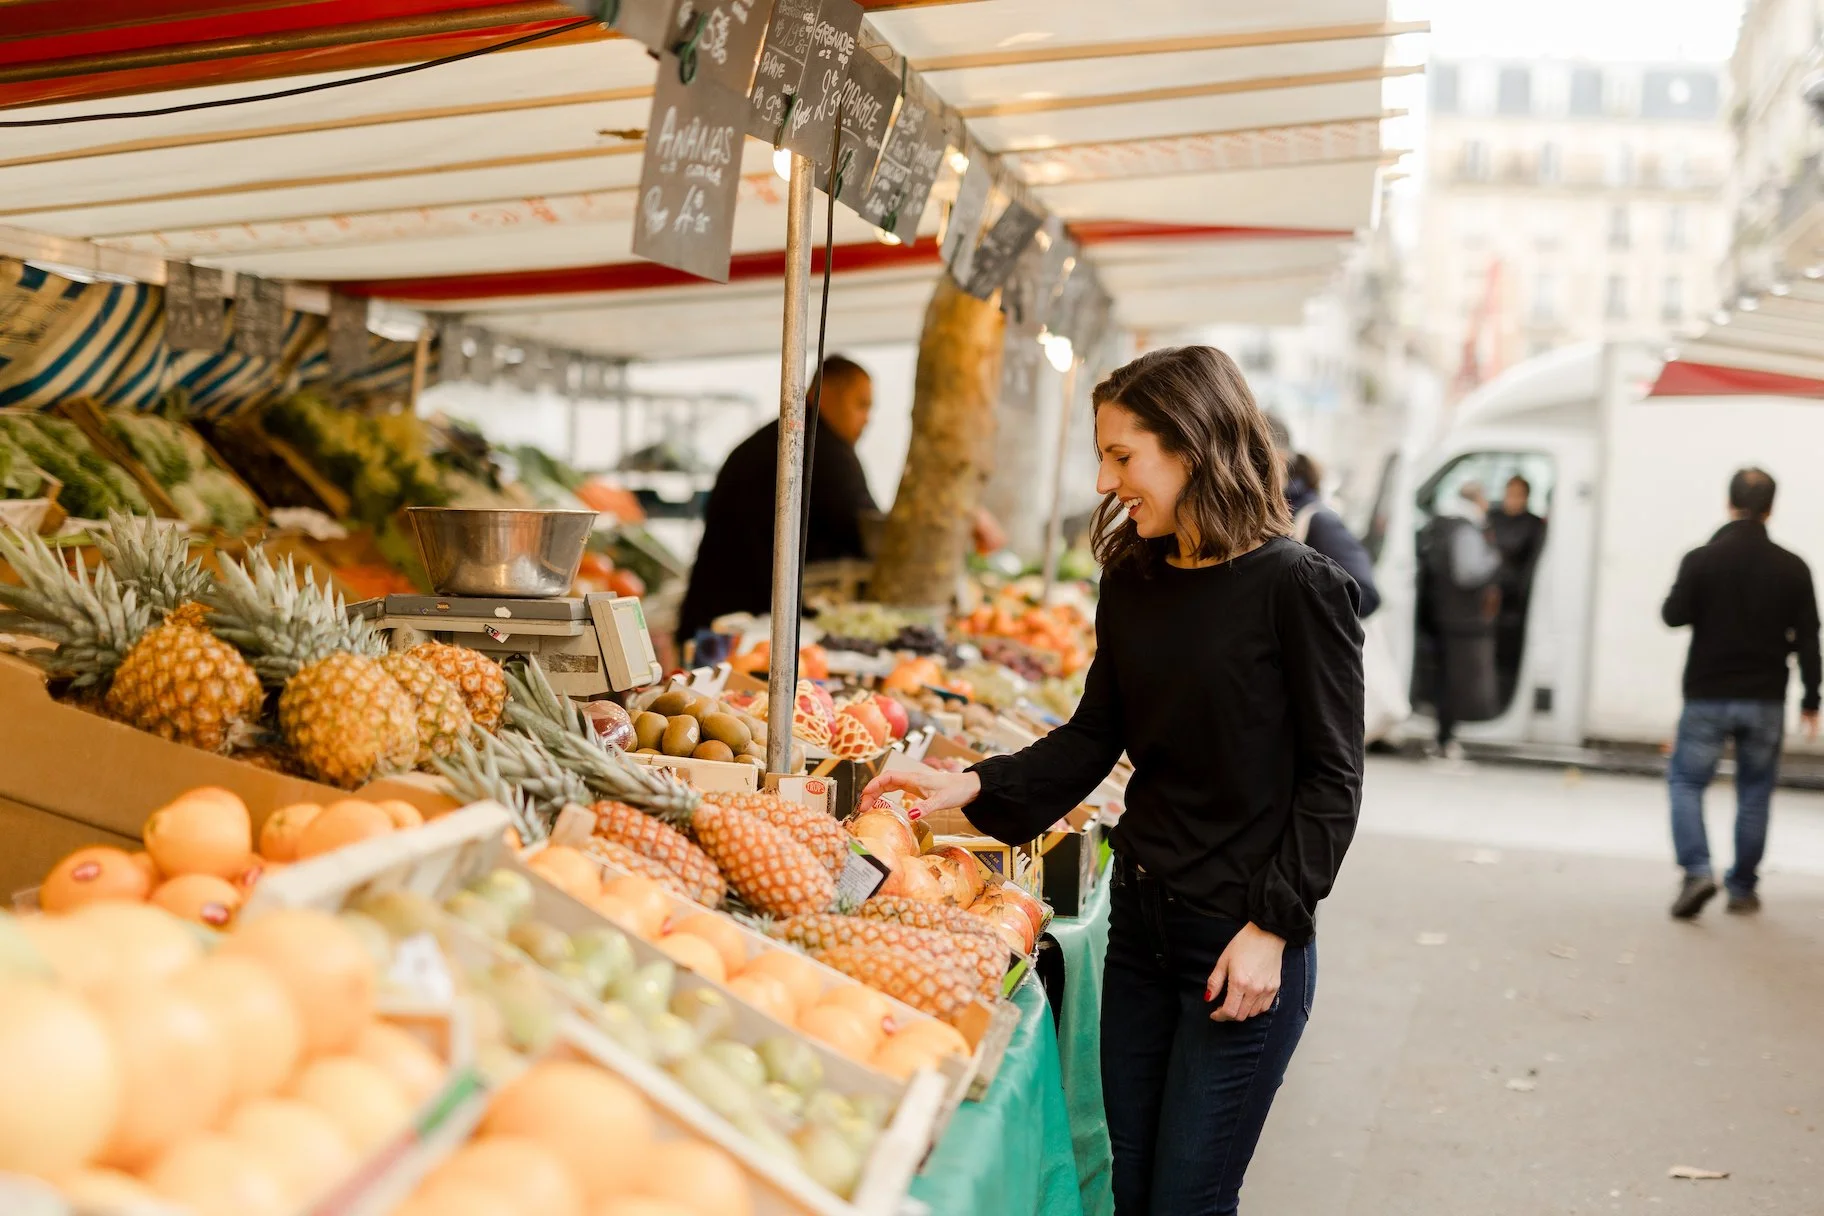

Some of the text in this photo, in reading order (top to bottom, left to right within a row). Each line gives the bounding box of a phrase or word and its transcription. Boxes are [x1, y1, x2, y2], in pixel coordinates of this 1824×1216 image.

[814, 21, 855, 55] GRENADE
[841, 78, 882, 131] MANGUE
[655, 105, 734, 164] ANANAS
[806, 781, 825, 793] TROPS
